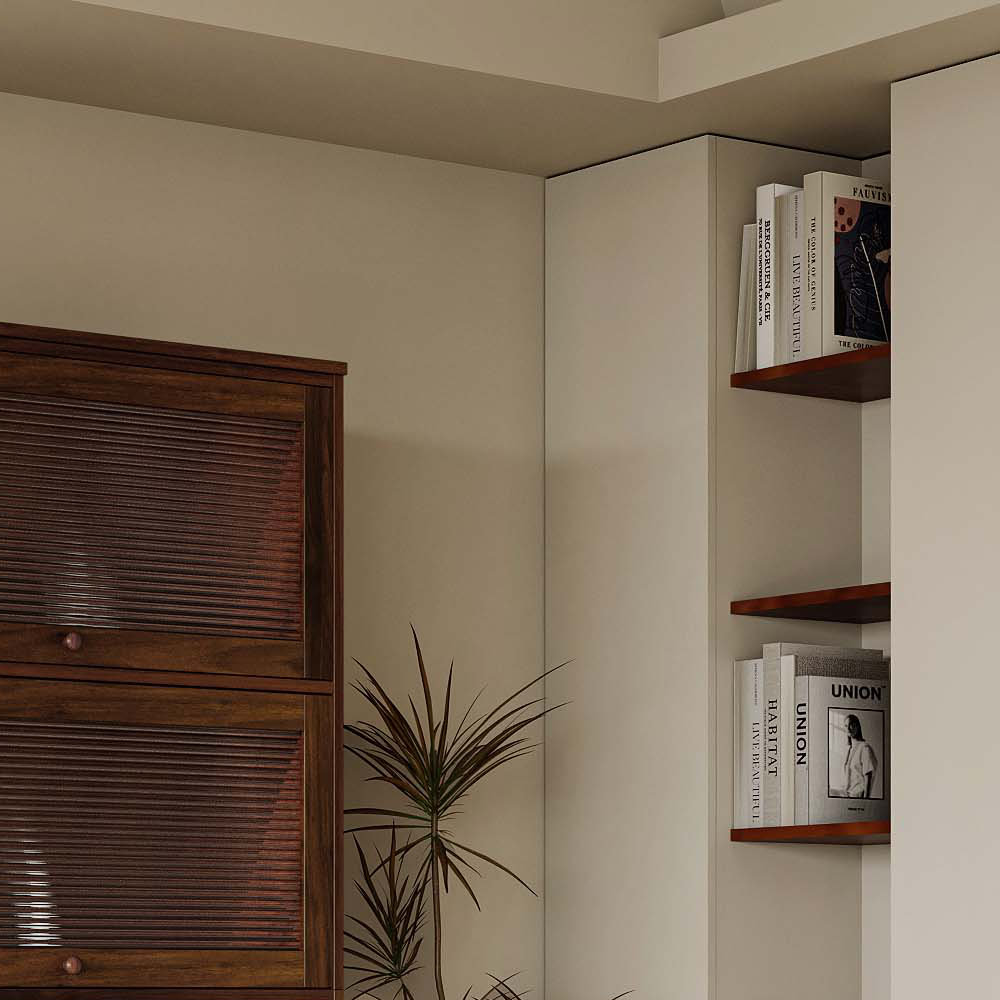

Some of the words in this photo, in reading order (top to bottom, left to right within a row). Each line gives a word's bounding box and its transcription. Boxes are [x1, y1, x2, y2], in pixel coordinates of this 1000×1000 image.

[792, 254, 801, 285] LIVE
[811, 267, 816, 277] OF
[839, 340, 851, 348] THE
[831, 684, 881, 700] UNION
[752, 721, 760, 750] LIVE
[767, 699, 778, 777] HABITAT
[796, 703, 807, 765] UNION
